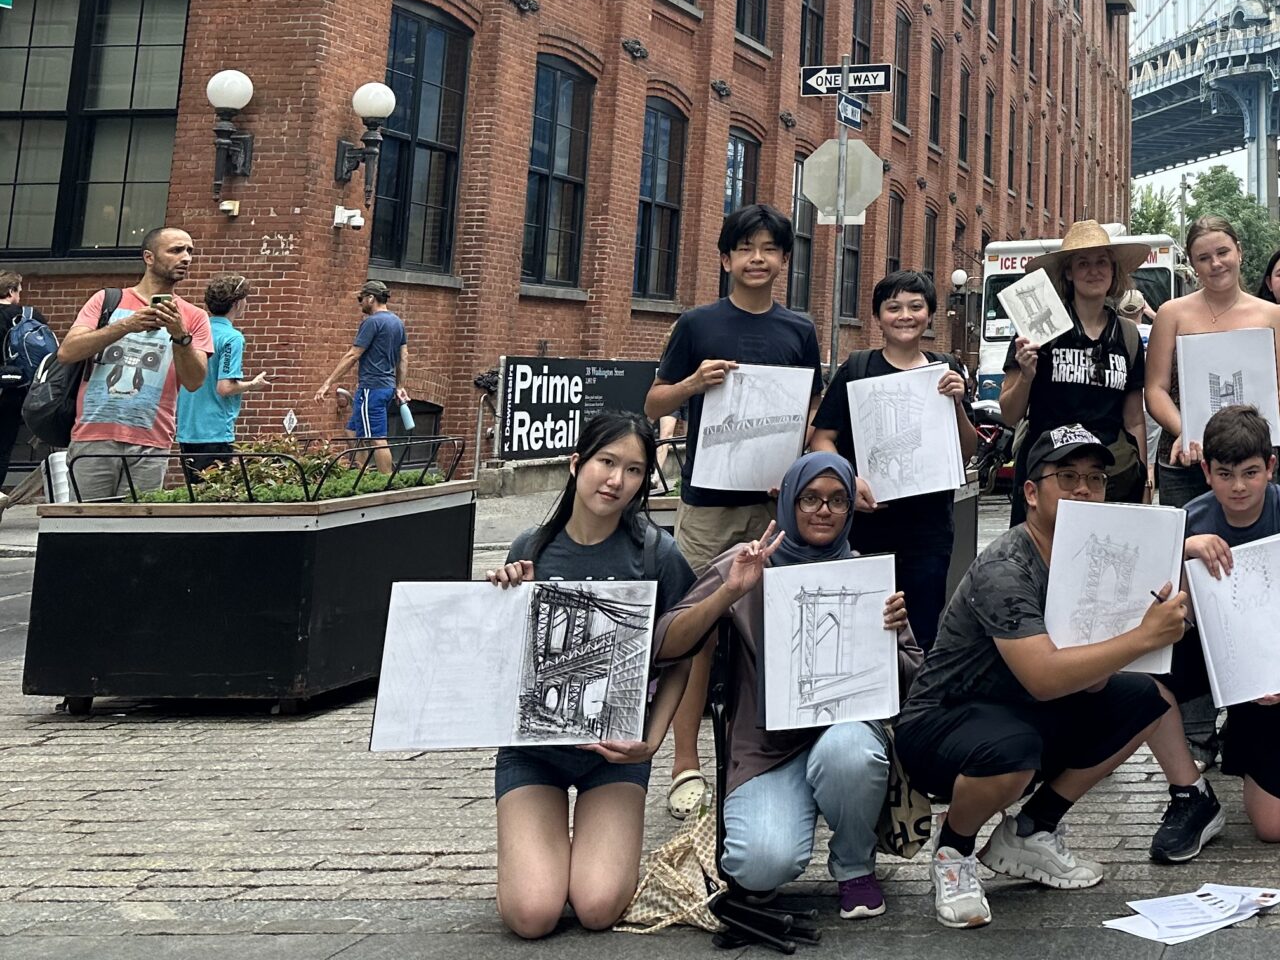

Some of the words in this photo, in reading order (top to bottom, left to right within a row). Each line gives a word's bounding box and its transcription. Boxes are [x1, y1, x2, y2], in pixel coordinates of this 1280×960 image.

[815, 74, 840, 87] ONE
[853, 73, 879, 86] WAY
[841, 103, 849, 117] ONE
[851, 107, 860, 121] WAY
[1000, 256, 1018, 270] ICE
[1108, 353, 1127, 374] FOR
[514, 364, 583, 404] Prime
[504, 364, 514, 436] Downstairs
[512, 409, 581, 451] Retail
